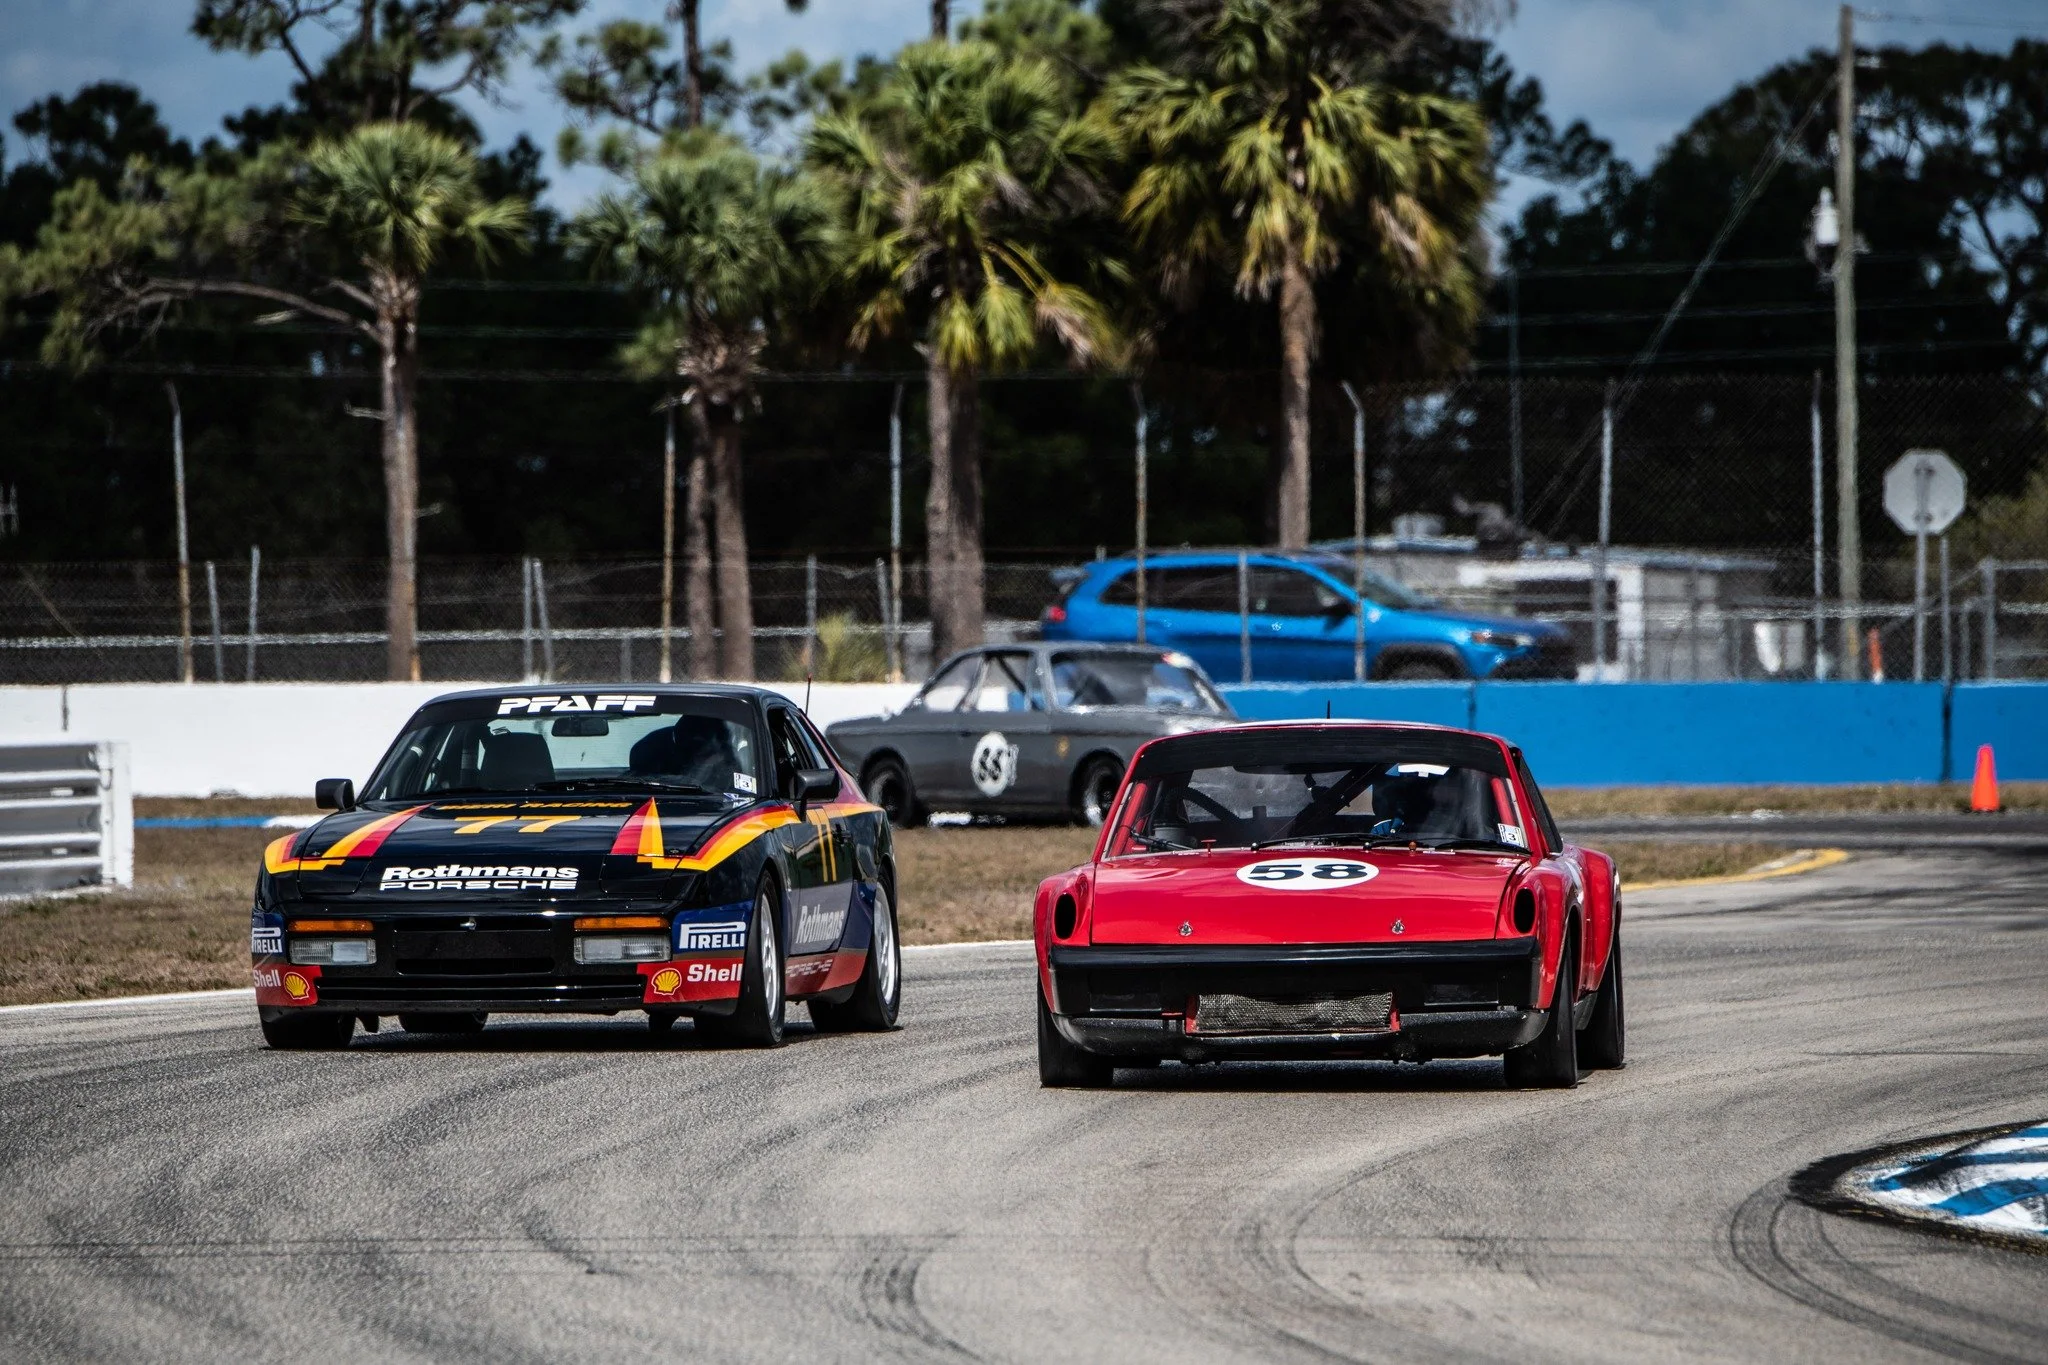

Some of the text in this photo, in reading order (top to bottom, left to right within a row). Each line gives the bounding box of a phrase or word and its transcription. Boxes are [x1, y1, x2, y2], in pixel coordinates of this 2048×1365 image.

[497, 695, 657, 715] PFAFF
[454, 815, 582, 834] 77
[381, 864, 580, 881] Rothmans
[1247, 864, 1368, 881] 58
[379, 880, 578, 891] PORSCHE
[795, 904, 845, 944] Rothmans
[251, 927, 283, 953] PIRELLI
[679, 921, 747, 949] PIRELLI
[253, 969, 282, 988] Shell
[687, 963, 743, 982] Shell
